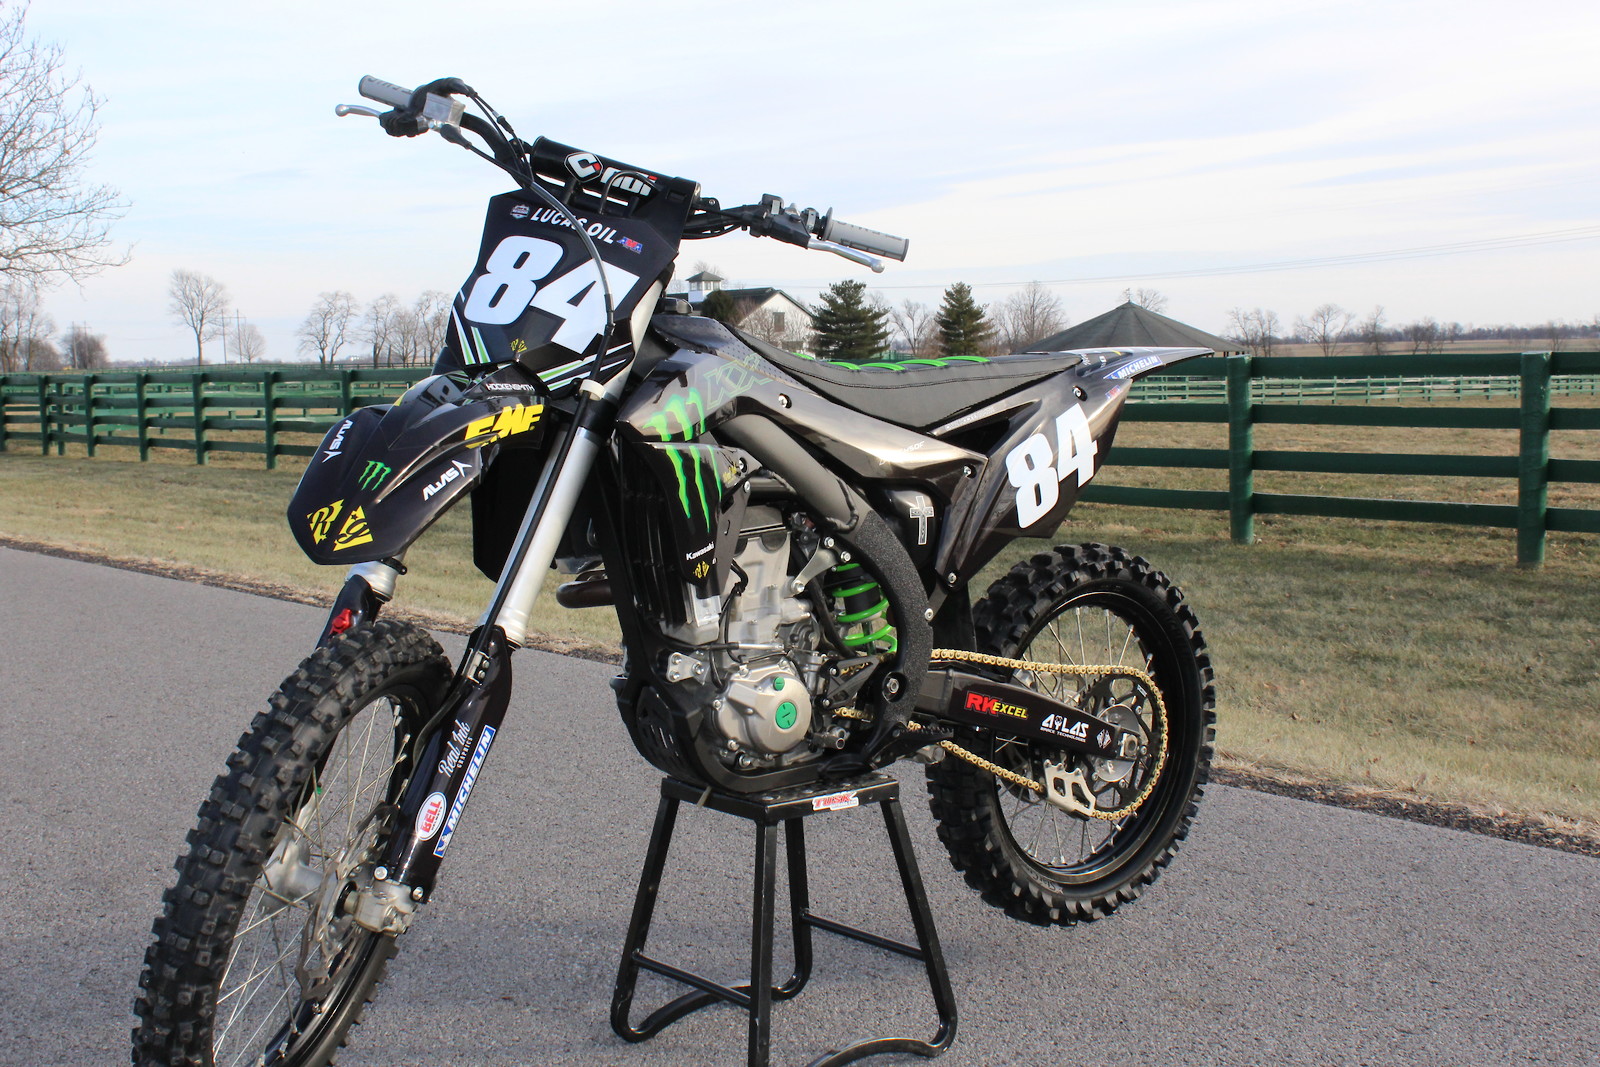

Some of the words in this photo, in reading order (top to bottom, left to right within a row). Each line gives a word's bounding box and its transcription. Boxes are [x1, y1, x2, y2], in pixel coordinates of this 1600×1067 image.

[586, 223, 622, 244] OIL
[463, 234, 640, 355] 84
[1116, 355, 1159, 379] MICHELIN
[485, 383, 535, 391] HOCKENSMITH
[1005, 402, 1098, 529] 84
[685, 541, 715, 560] Kawasaki
[992, 701, 1028, 719] EXCEL
[438, 741, 461, 777] Real
[452, 719, 470, 746] Ink
[448, 728, 493, 831] MICHELIN
[421, 800, 442, 833] BELL
